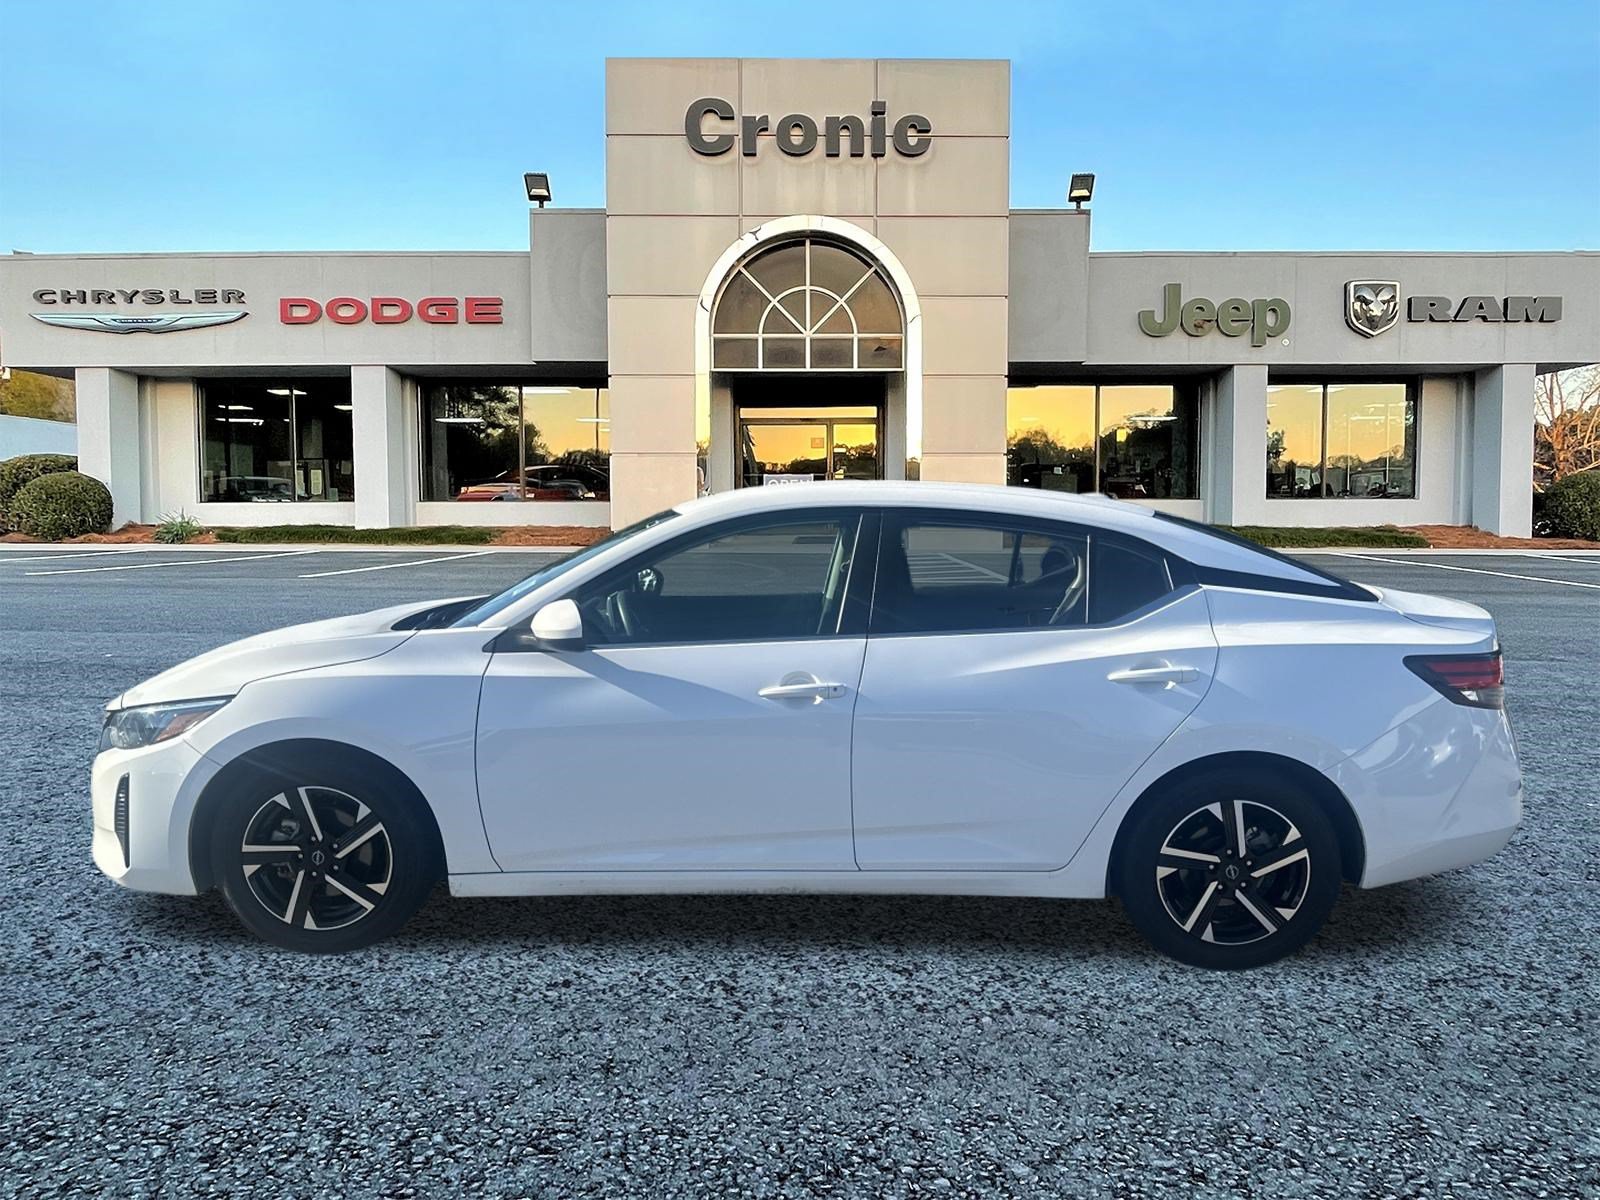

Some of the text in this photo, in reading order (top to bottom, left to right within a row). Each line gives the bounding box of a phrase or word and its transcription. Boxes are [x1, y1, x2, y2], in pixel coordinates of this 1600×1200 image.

[685, 97, 932, 157] Cronic
[32, 288, 246, 304] CHRYSLER
[1407, 296, 1563, 322] RAM
[280, 297, 503, 325] DODGE
[1138, 283, 1291, 348] Jeep
